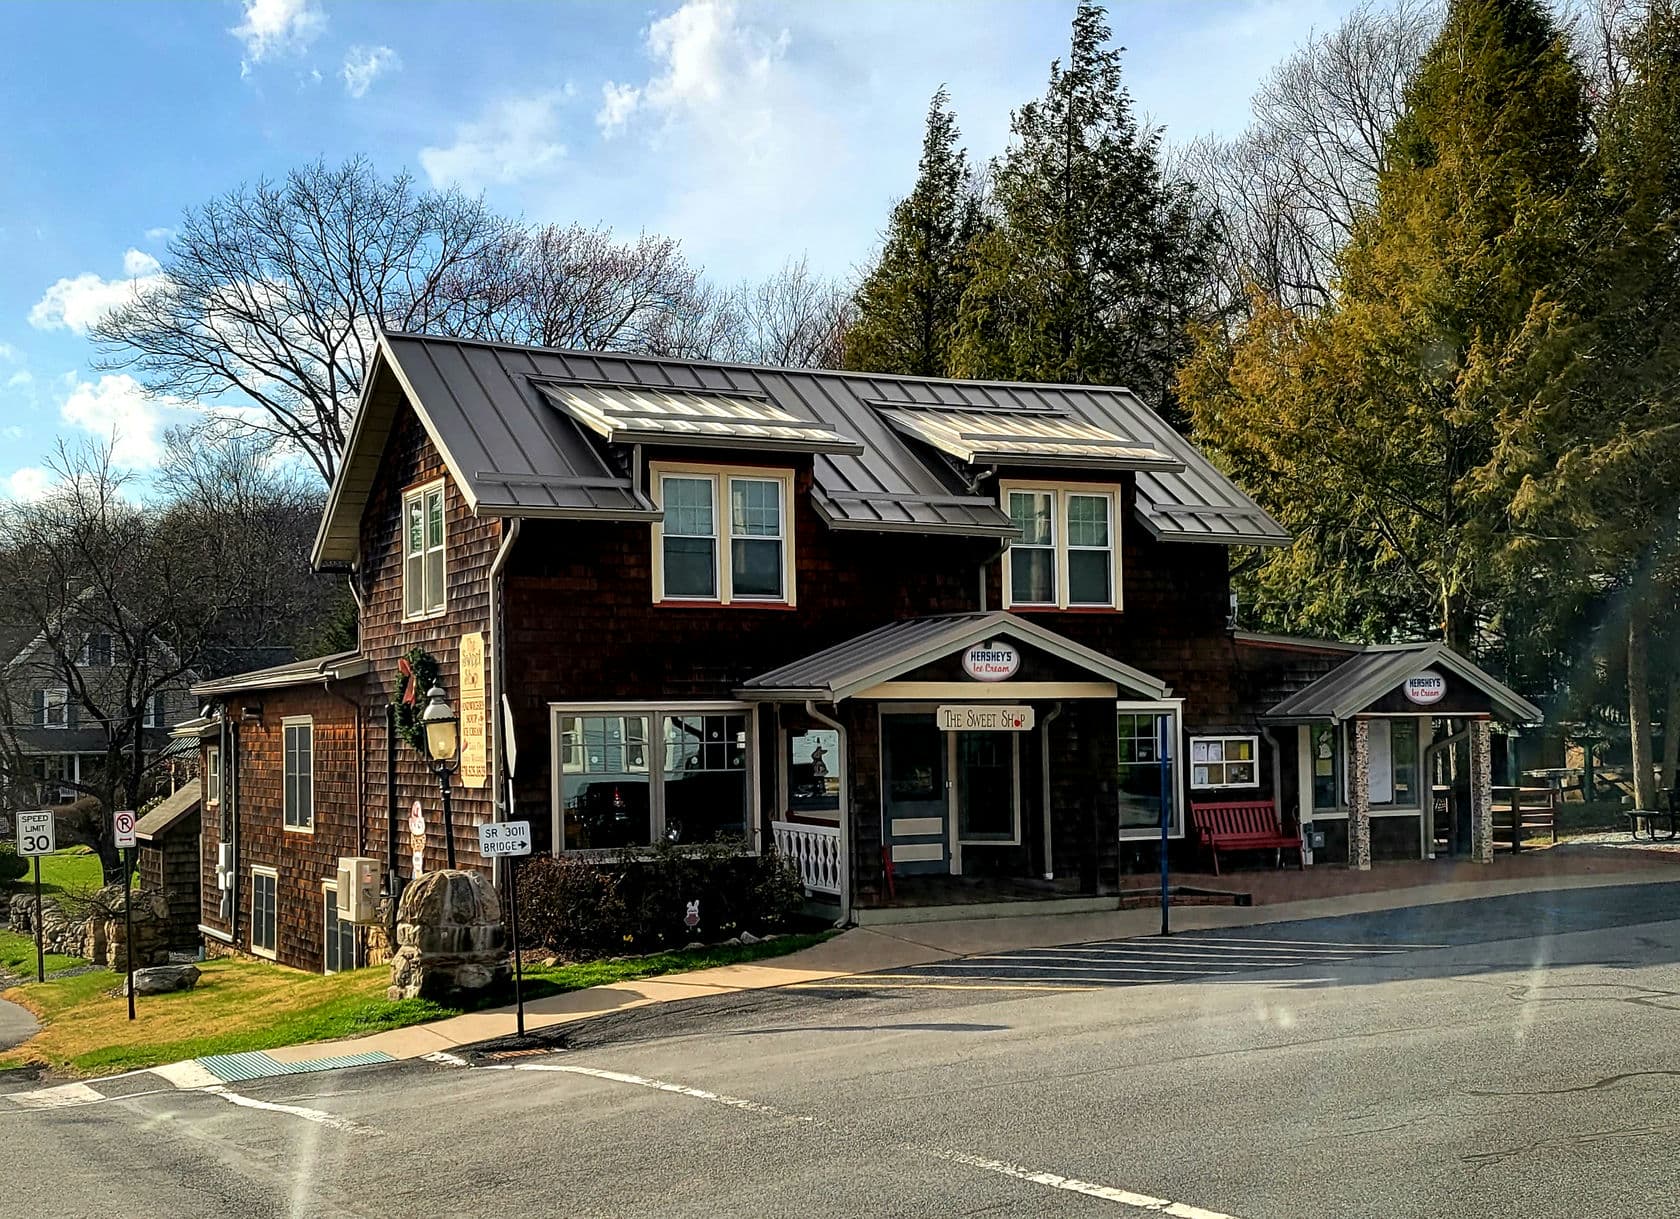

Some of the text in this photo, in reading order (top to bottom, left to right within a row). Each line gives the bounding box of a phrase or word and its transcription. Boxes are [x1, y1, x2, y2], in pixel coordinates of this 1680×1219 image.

[970, 651, 1012, 662] HERSHEY'S
[973, 663, 1010, 673] Ice Cream
[1409, 678, 1441, 688] HERSHEY'S
[1411, 687, 1440, 697] Ice Cream
[944, 710, 962, 728] THE
[966, 709, 997, 728] SWEET
[21, 815, 49, 823] SPEED
[25, 825, 46, 833] LIMIT
[485, 826, 525, 839] SR 3011
[23, 835, 50, 851] 30
[484, 841, 518, 853] BRIDGE
